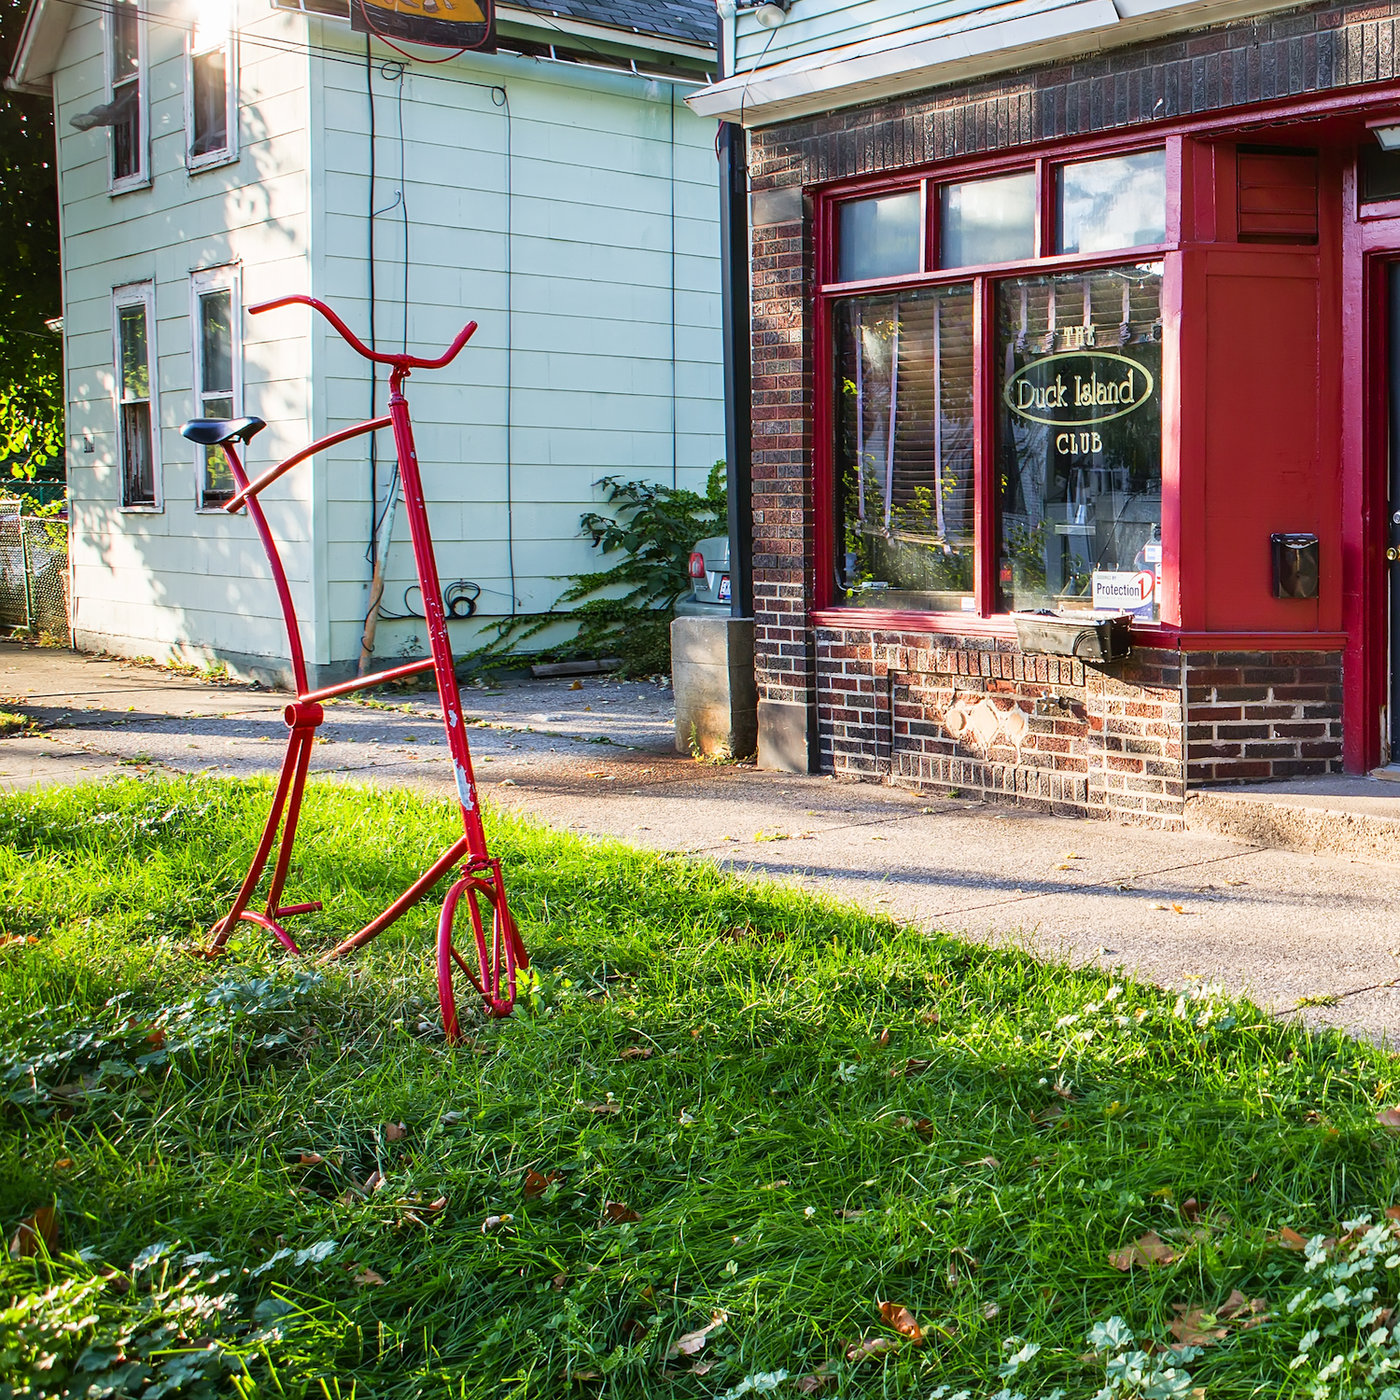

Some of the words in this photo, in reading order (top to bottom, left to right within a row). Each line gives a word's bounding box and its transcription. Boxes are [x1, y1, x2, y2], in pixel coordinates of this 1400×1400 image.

[1063, 323, 1096, 347] THE
[1016, 373, 1069, 410] Duck
[1074, 368, 1136, 407] Island
[1055, 431, 1103, 455] CLUB
[1096, 582, 1140, 598] Protection
